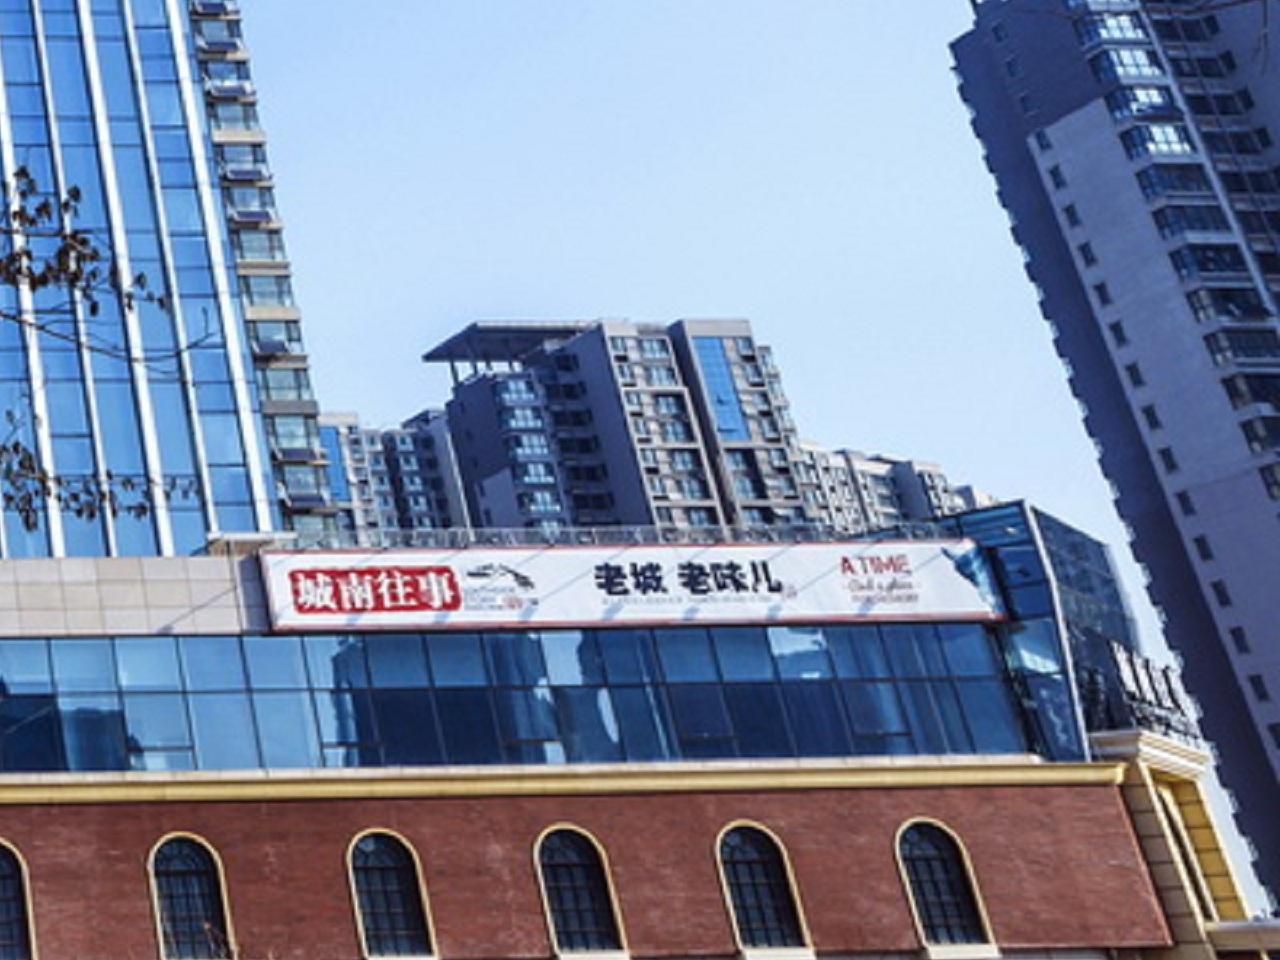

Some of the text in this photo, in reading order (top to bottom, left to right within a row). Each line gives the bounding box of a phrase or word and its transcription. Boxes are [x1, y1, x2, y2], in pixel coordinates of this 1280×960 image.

[295, 571, 453, 609] 城南往事
[594, 560, 783, 595] 老城 老味儿
